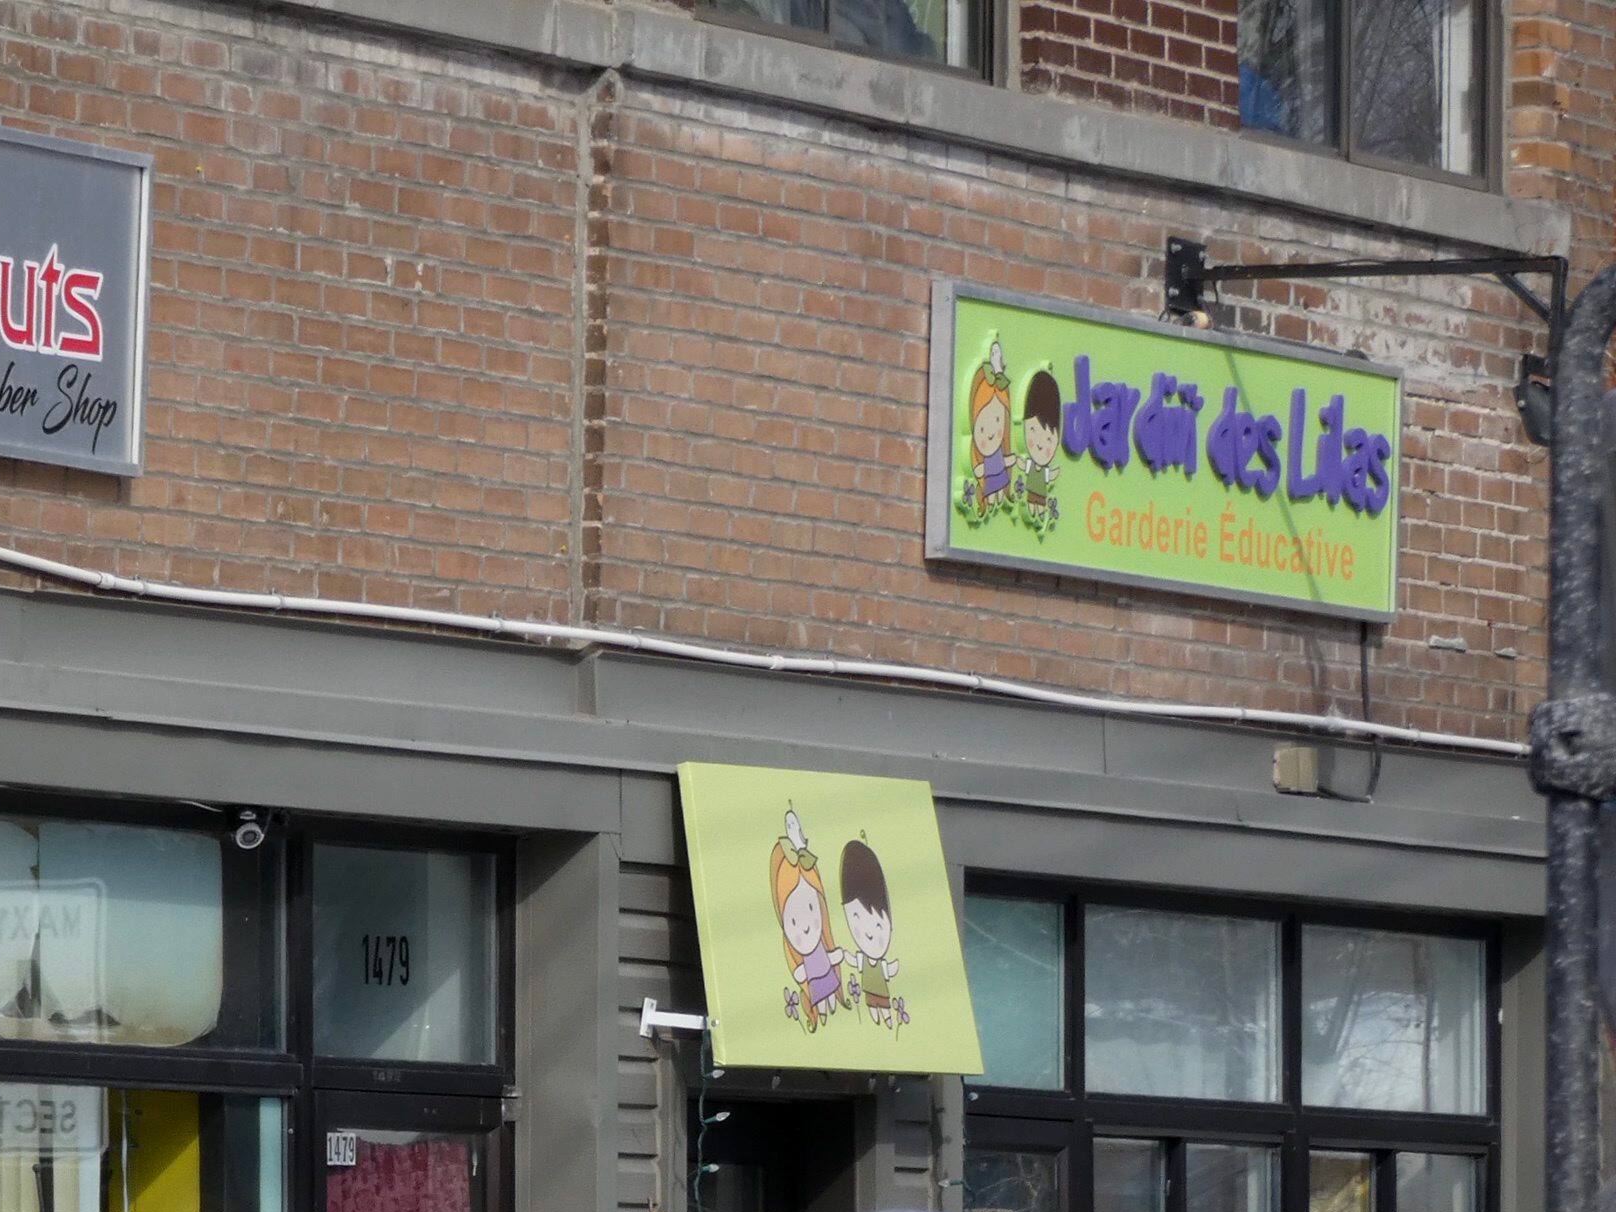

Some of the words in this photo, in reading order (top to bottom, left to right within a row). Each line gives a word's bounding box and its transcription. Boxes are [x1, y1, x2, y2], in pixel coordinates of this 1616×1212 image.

[42, 362, 118, 455] Shop
[1206, 386, 1283, 496] des
[1085, 491, 1209, 560] Garderie
[1219, 502, 1355, 581] Éducative
[361, 933, 411, 987] 1479
[327, 1135, 356, 1165] 1479
